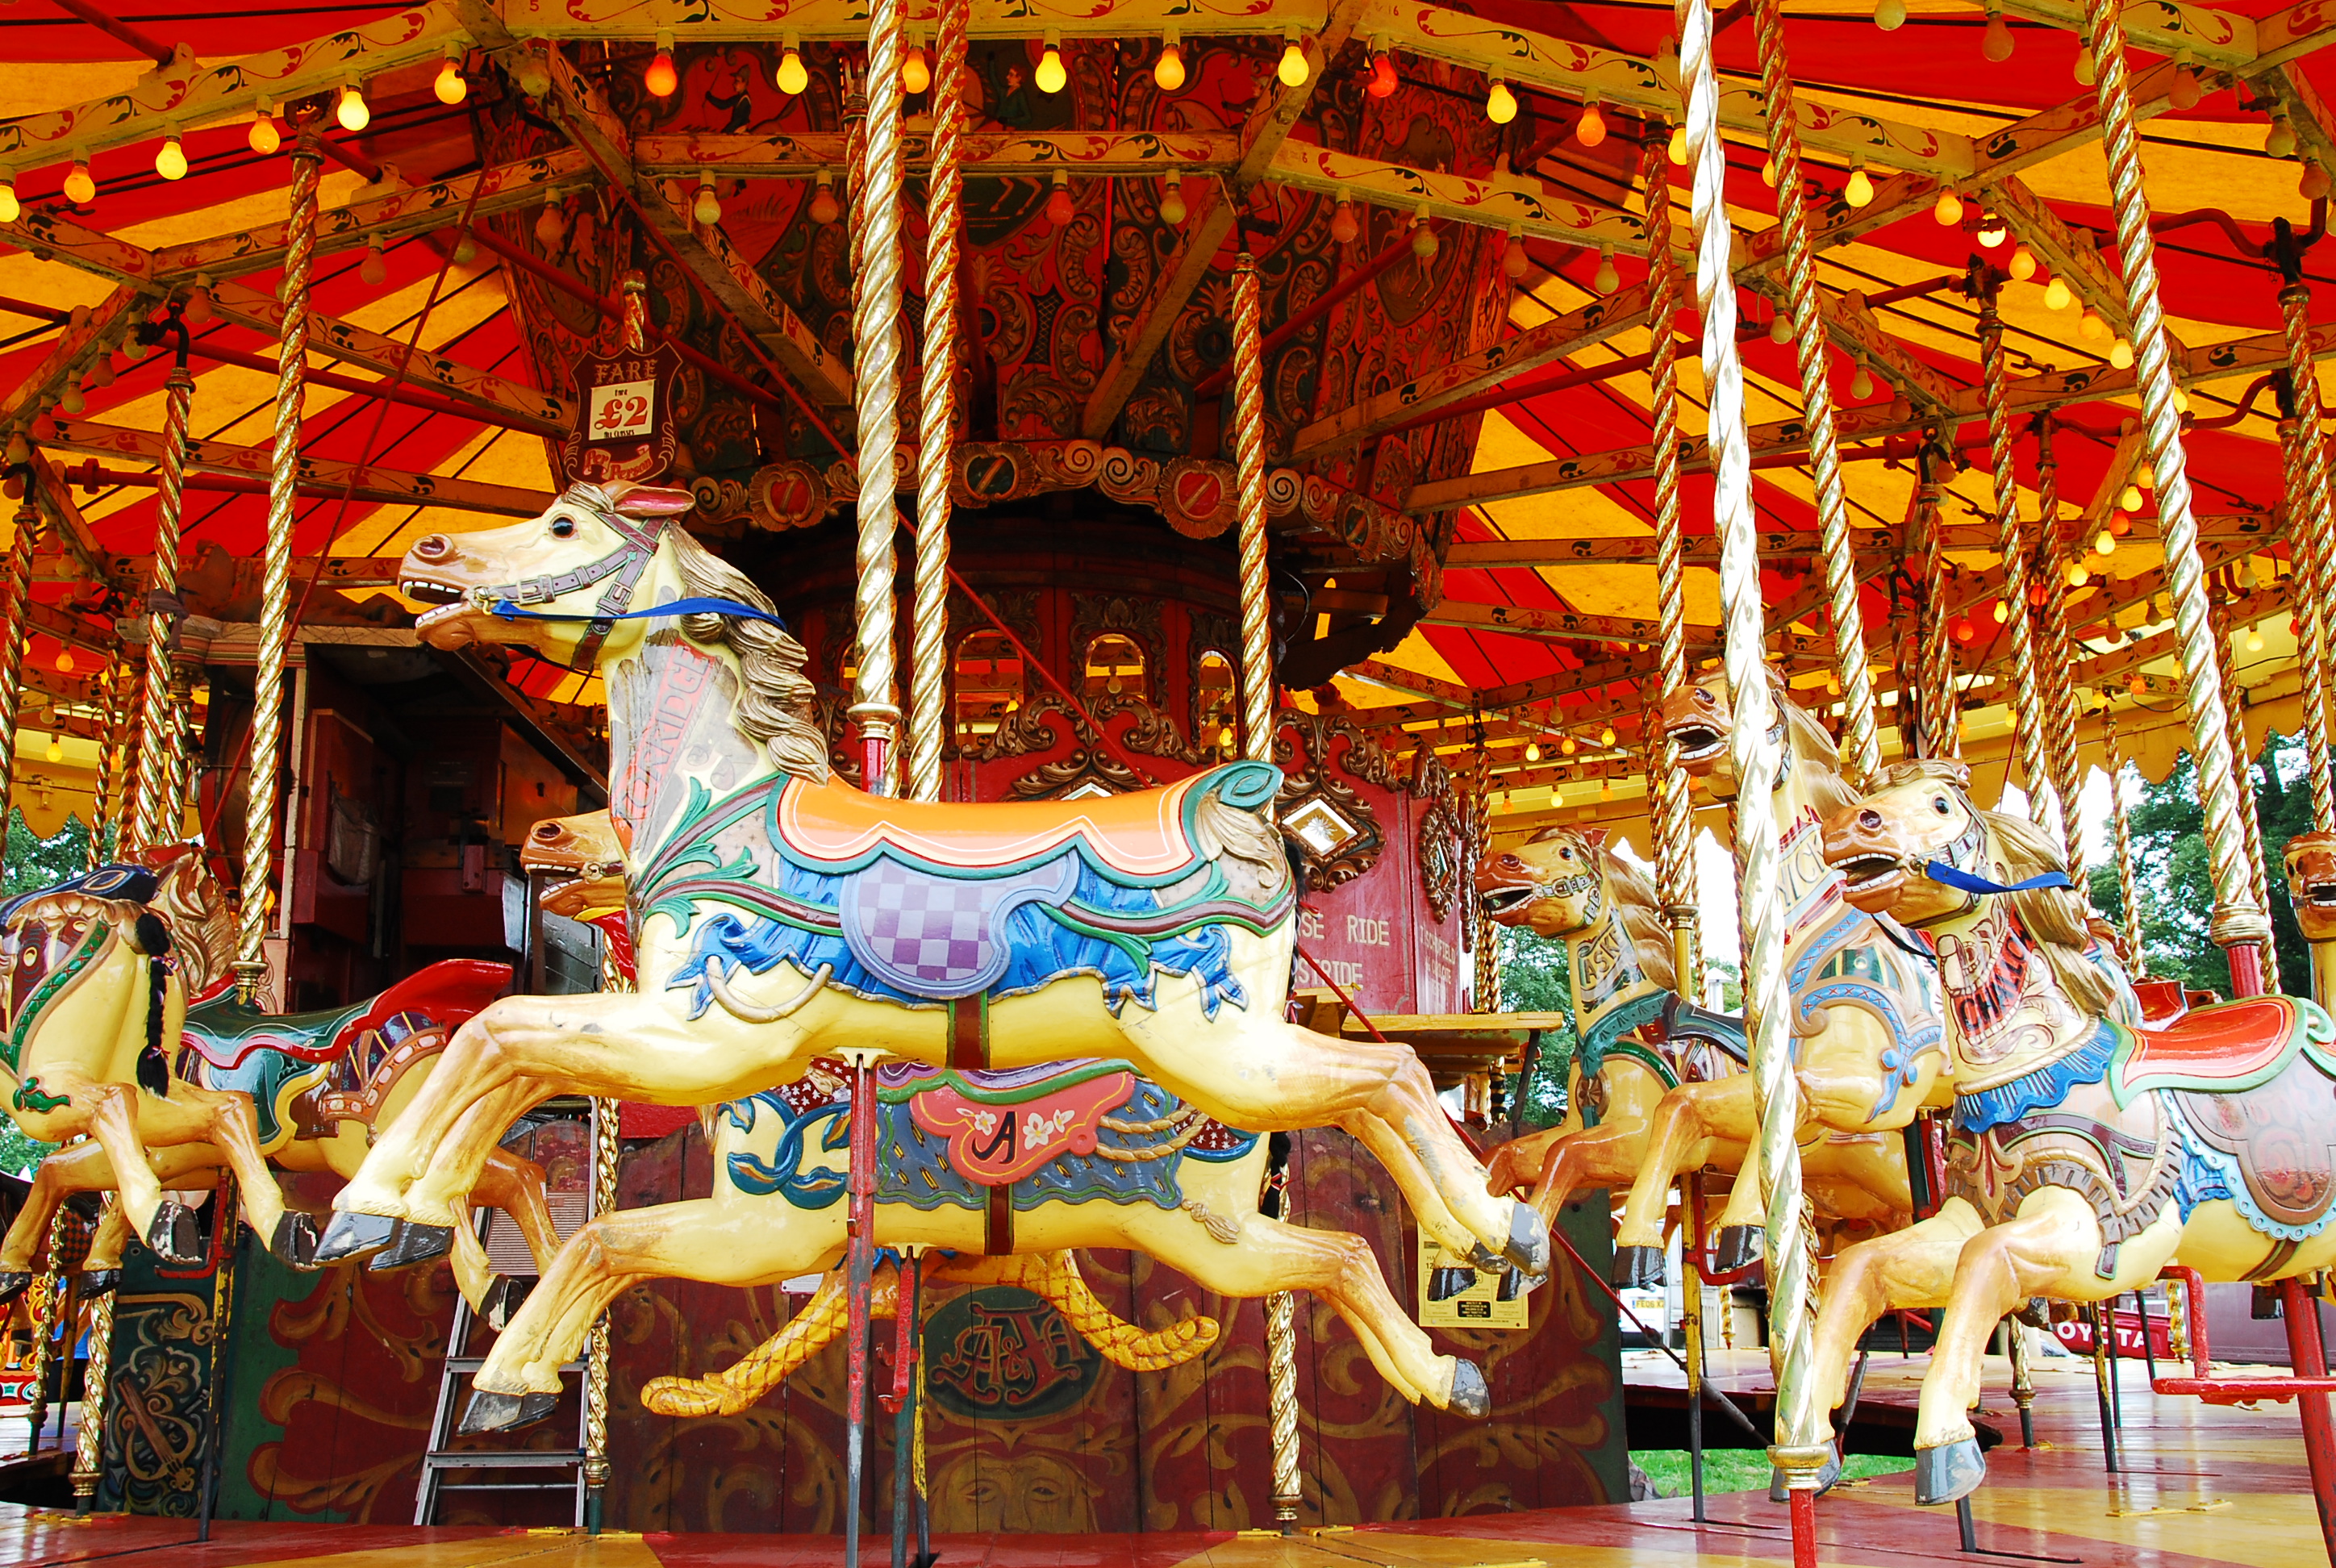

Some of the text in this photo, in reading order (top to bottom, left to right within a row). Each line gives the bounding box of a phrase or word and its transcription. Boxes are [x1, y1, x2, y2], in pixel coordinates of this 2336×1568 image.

[650, 141, 663, 160] 5
[594, 359, 658, 385] FARE
[594, 395, 649, 431] £2
[587, 450, 653, 481] Per Person
[1297, 911, 1390, 946] SE RIDE
[1294, 957, 1364, 989] STRIDE
[970, 1111, 1018, 1165] A
[1636, 1299, 1655, 1307] FE06
